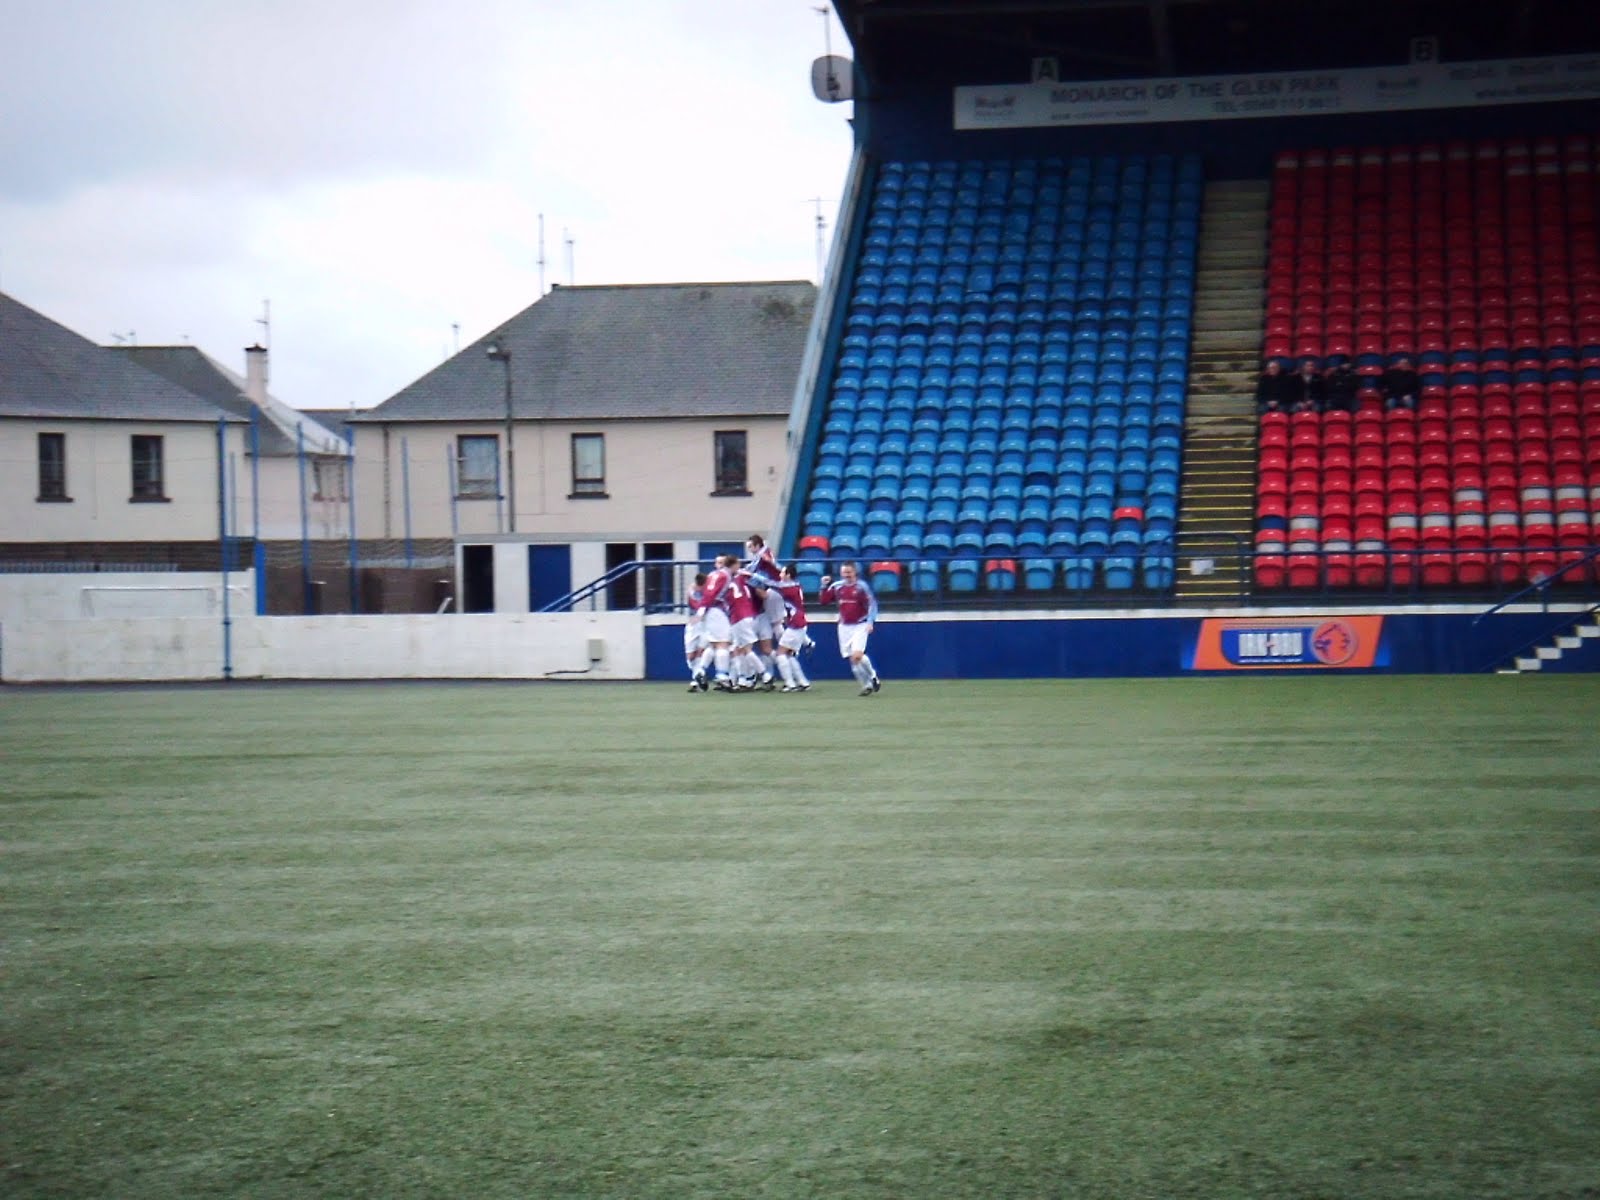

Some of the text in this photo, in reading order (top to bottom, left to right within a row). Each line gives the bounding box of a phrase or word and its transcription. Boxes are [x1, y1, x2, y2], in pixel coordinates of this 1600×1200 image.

[1038, 59, 1055, 80] A
[1049, 87, 1147, 103] MONARCH
[1155, 84, 1178, 100] OF
[1187, 82, 1224, 97] THE
[1232, 79, 1282, 95] GLEN
[729, 582, 751, 599] 21
